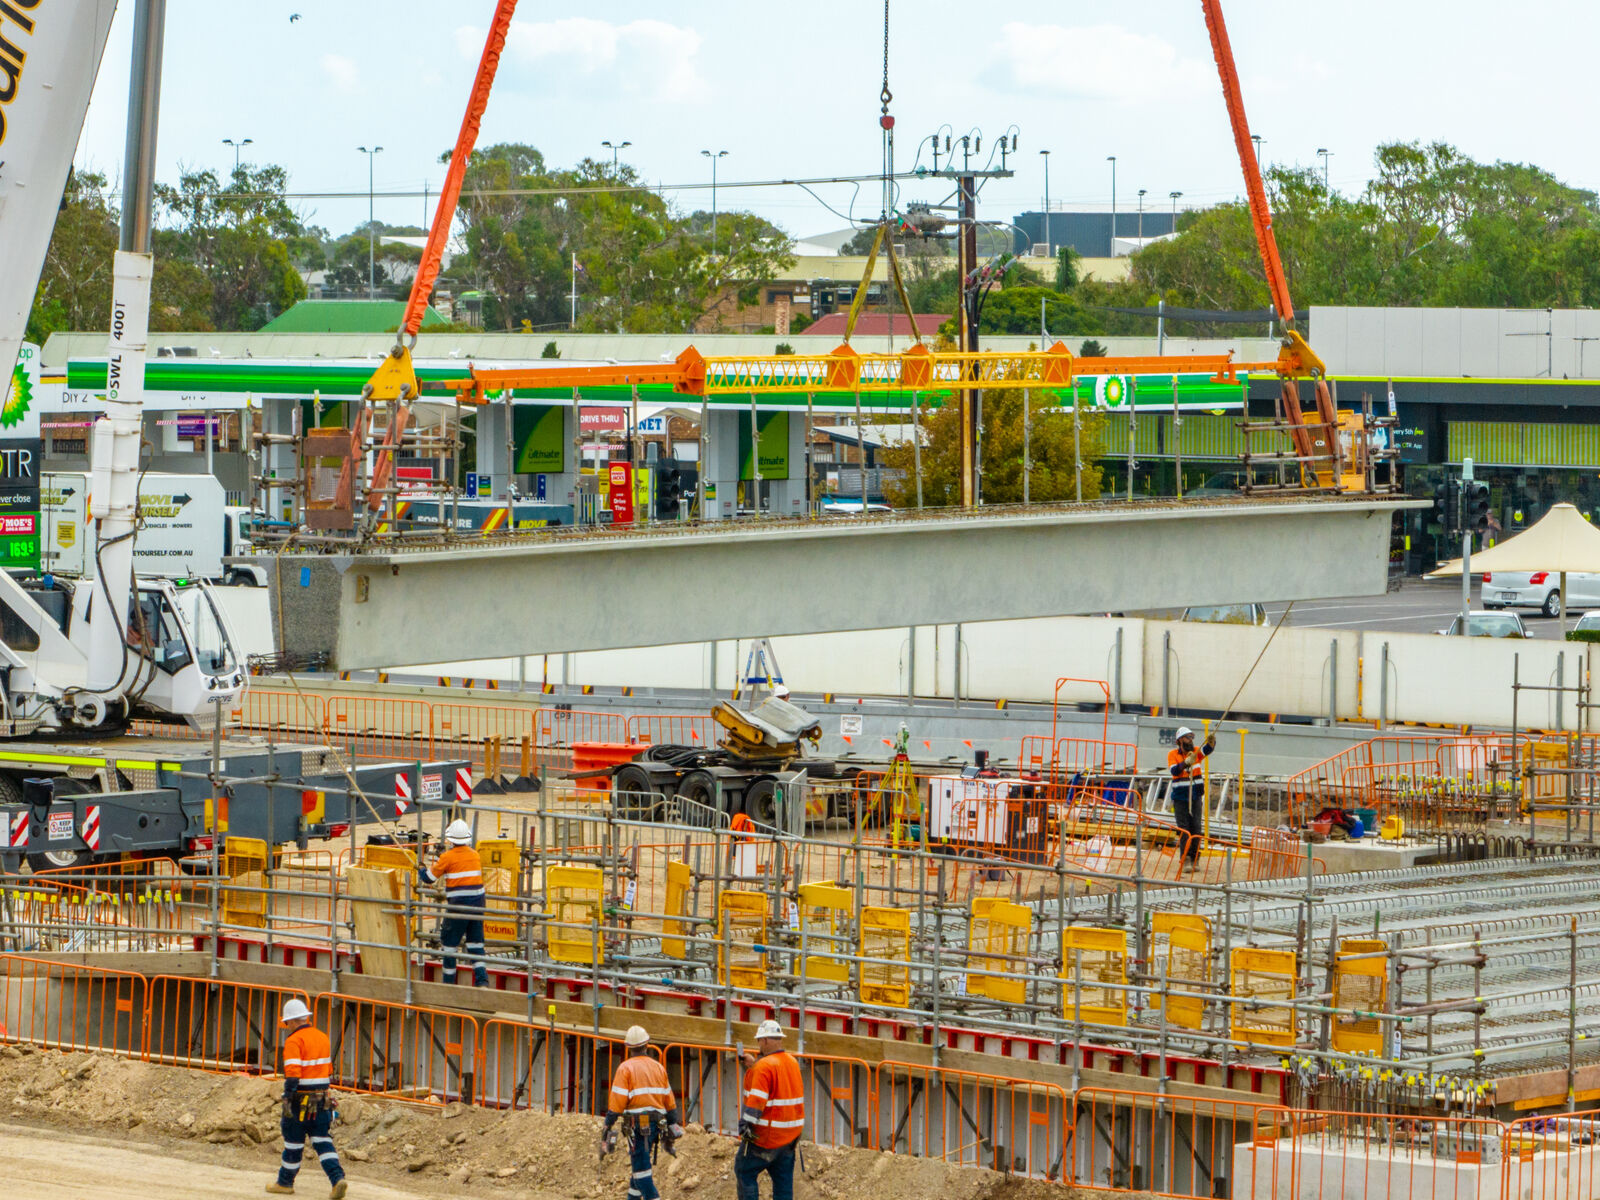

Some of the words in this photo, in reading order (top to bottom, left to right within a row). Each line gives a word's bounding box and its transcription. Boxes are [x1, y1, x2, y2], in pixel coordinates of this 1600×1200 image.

[113, 300, 126, 341] 400T
[109, 354, 122, 390] SWL
[62, 392, 78, 403] DIY
[580, 414, 599, 424] DRIVE
[601, 414, 620, 424] THRU
[636, 417, 663, 431] NET
[0, 448, 32, 479] TR
[13, 493, 31, 503] close
